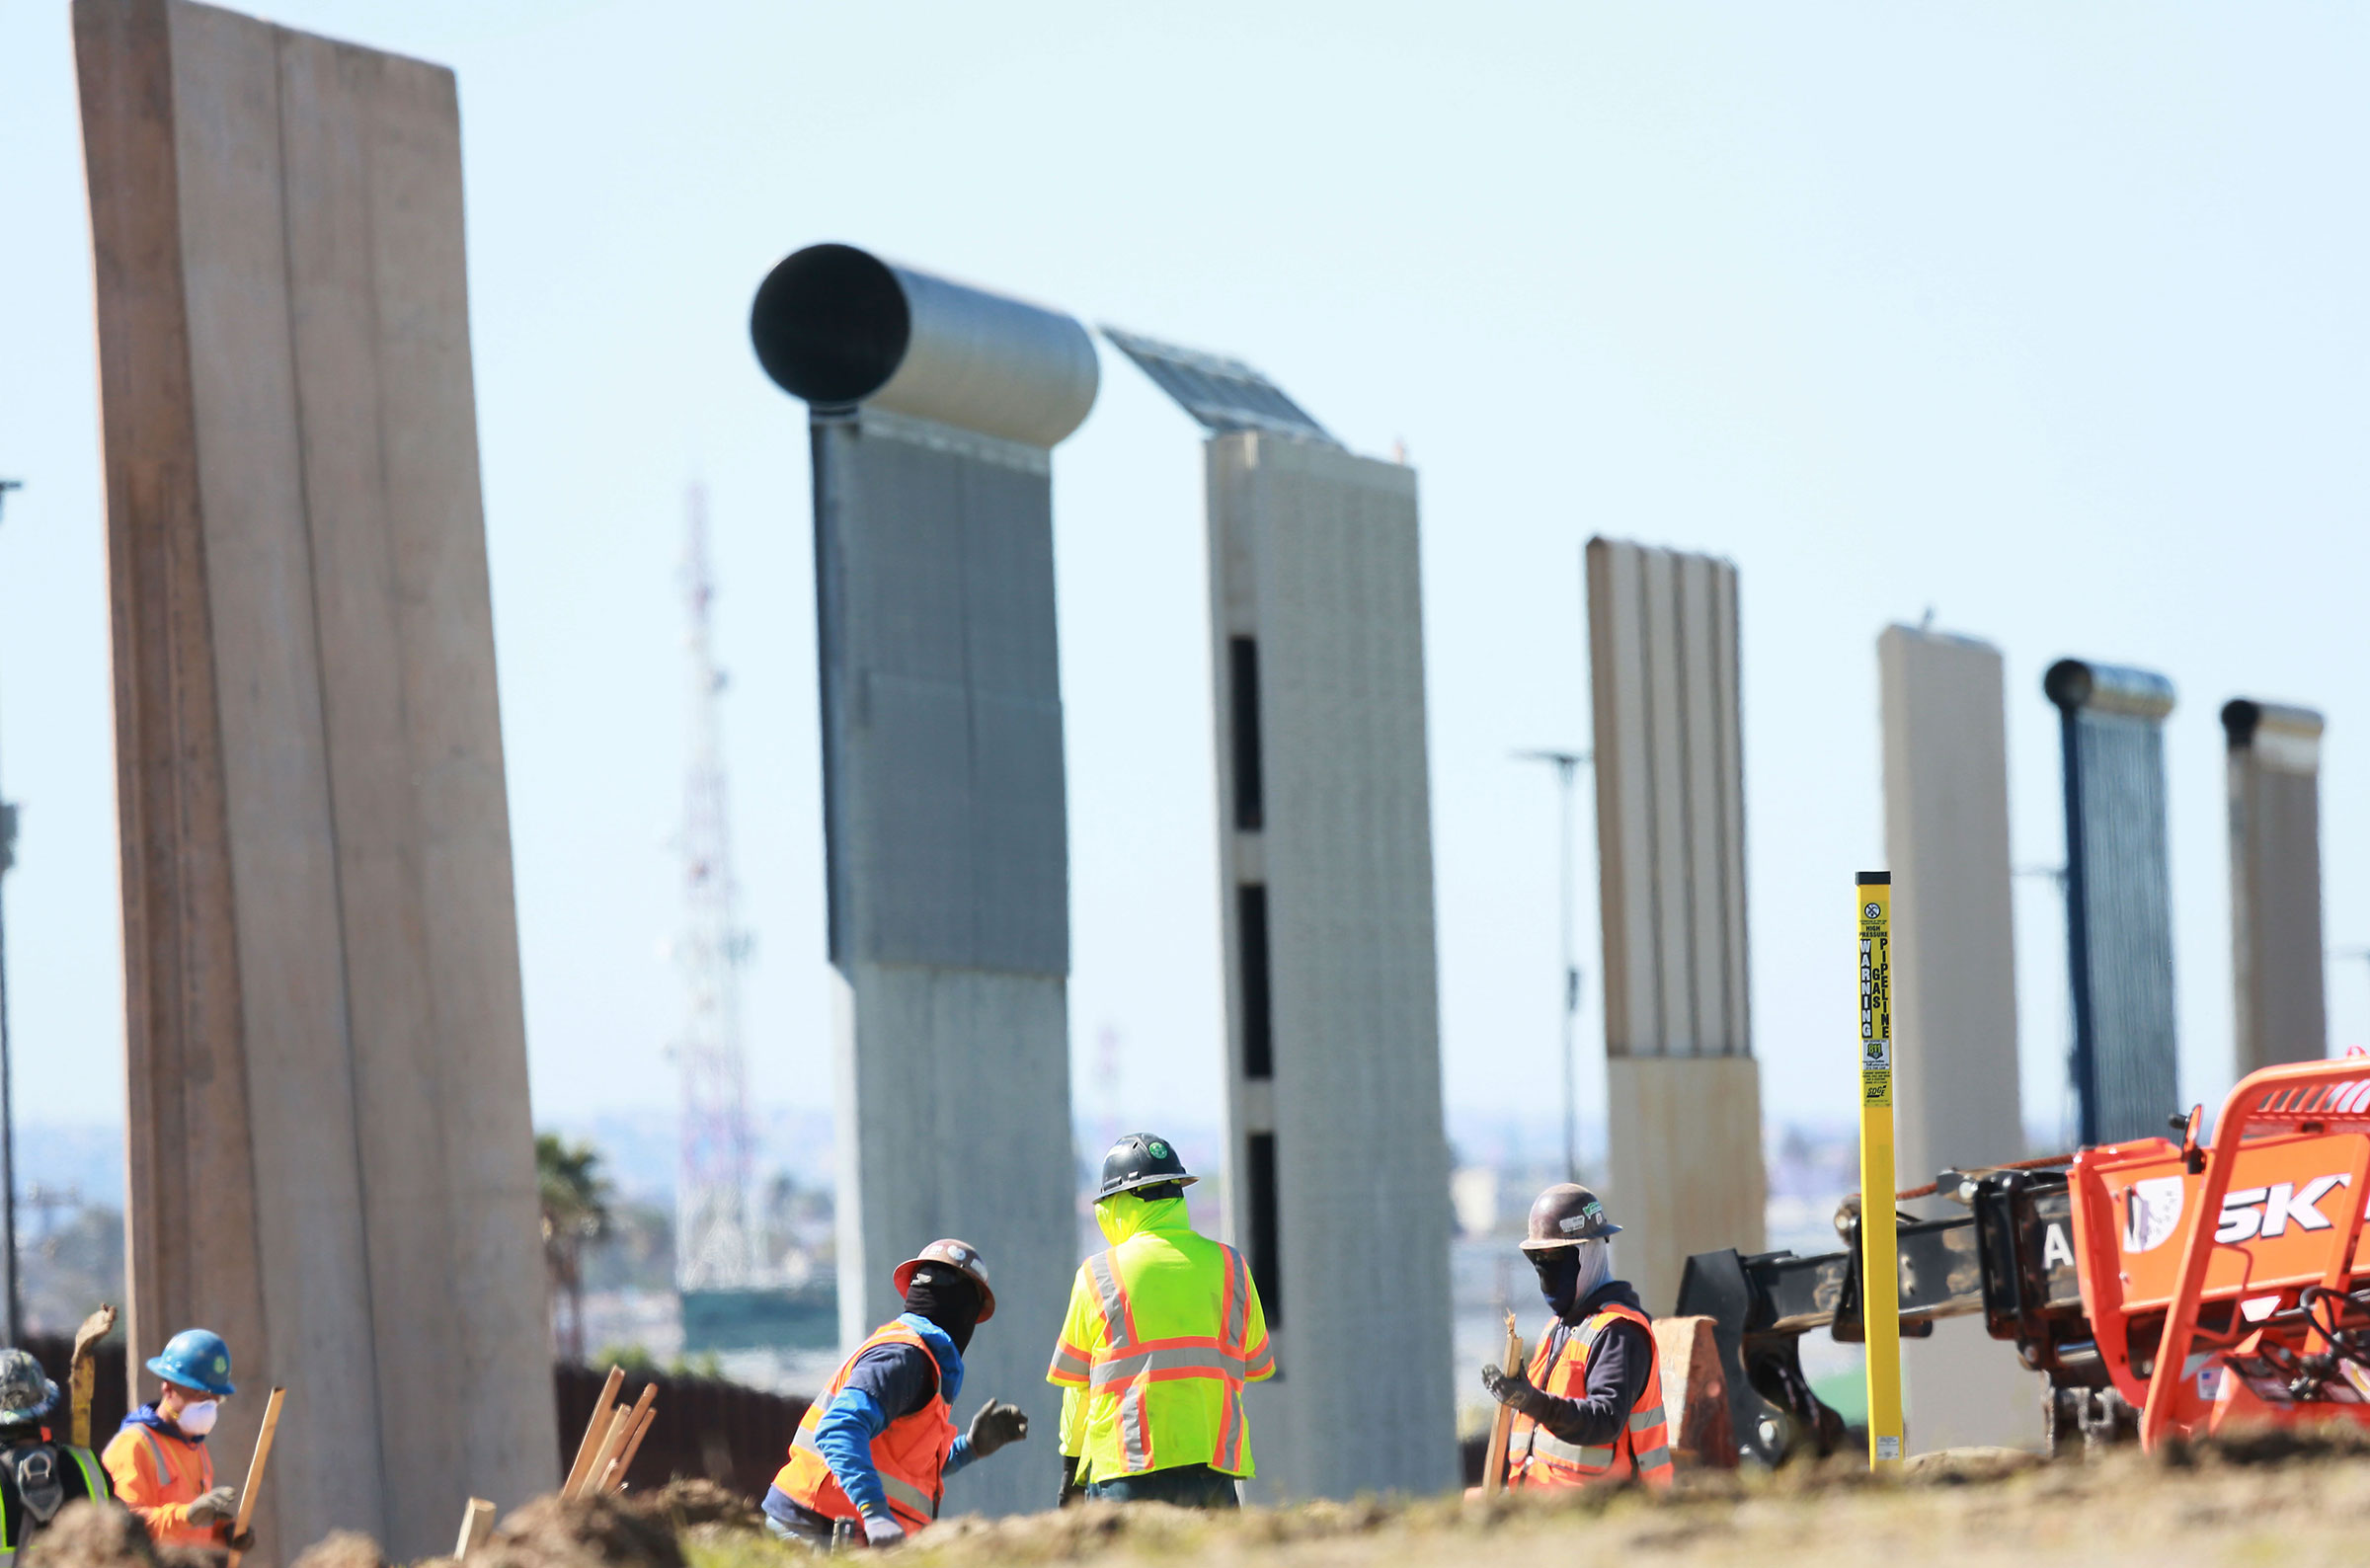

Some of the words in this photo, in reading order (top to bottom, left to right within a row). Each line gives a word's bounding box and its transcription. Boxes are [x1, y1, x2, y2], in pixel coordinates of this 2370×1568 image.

[1860, 939, 1871, 1037] WARNING
[1880, 938, 1889, 1038] PIPELINE
[1868, 1044, 1881, 1054] 811
[2214, 1173, 2370, 1244] SK
[2043, 1223, 2075, 1270] A
